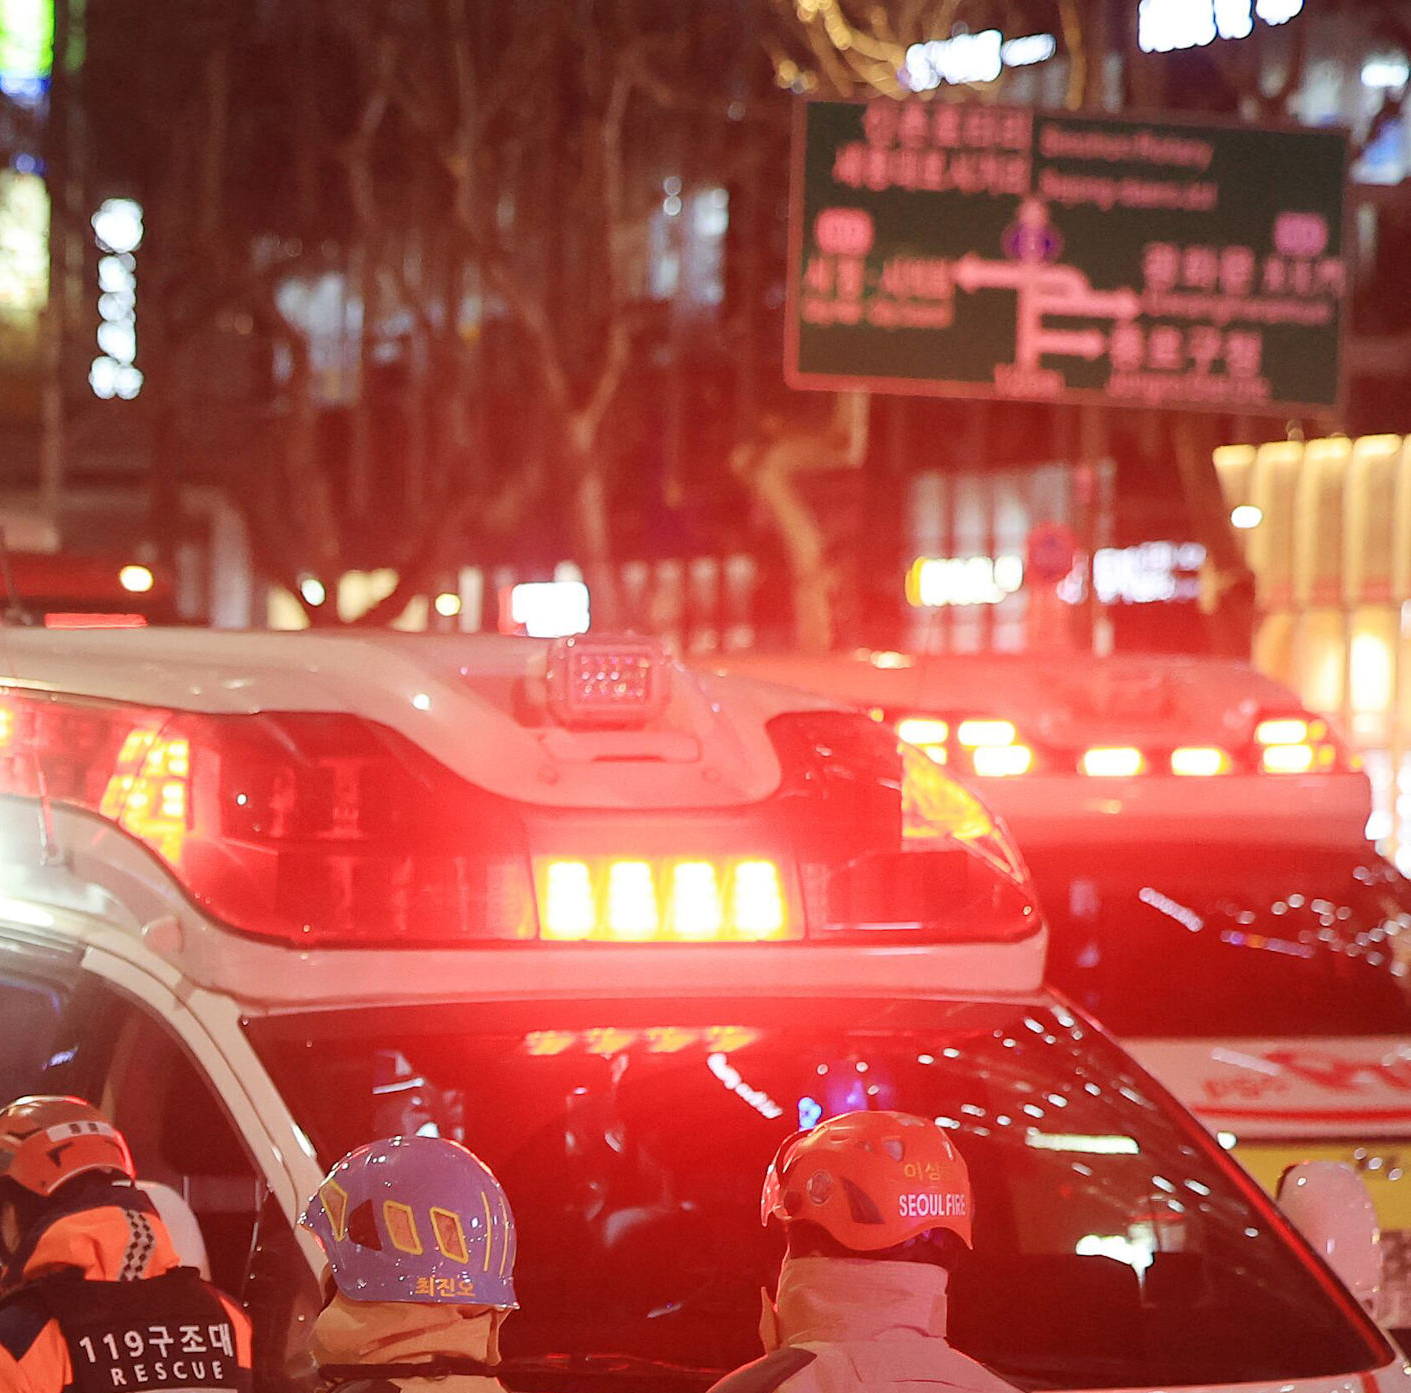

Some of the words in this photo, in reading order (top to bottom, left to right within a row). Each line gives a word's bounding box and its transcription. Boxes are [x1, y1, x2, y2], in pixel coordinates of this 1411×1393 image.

[898, 1193, 945, 1217] SEOUL
[945, 1193, 967, 1216] FIRE
[79, 1322, 234, 1364] 119구조대
[110, 1359, 224, 1387] RESCUE
